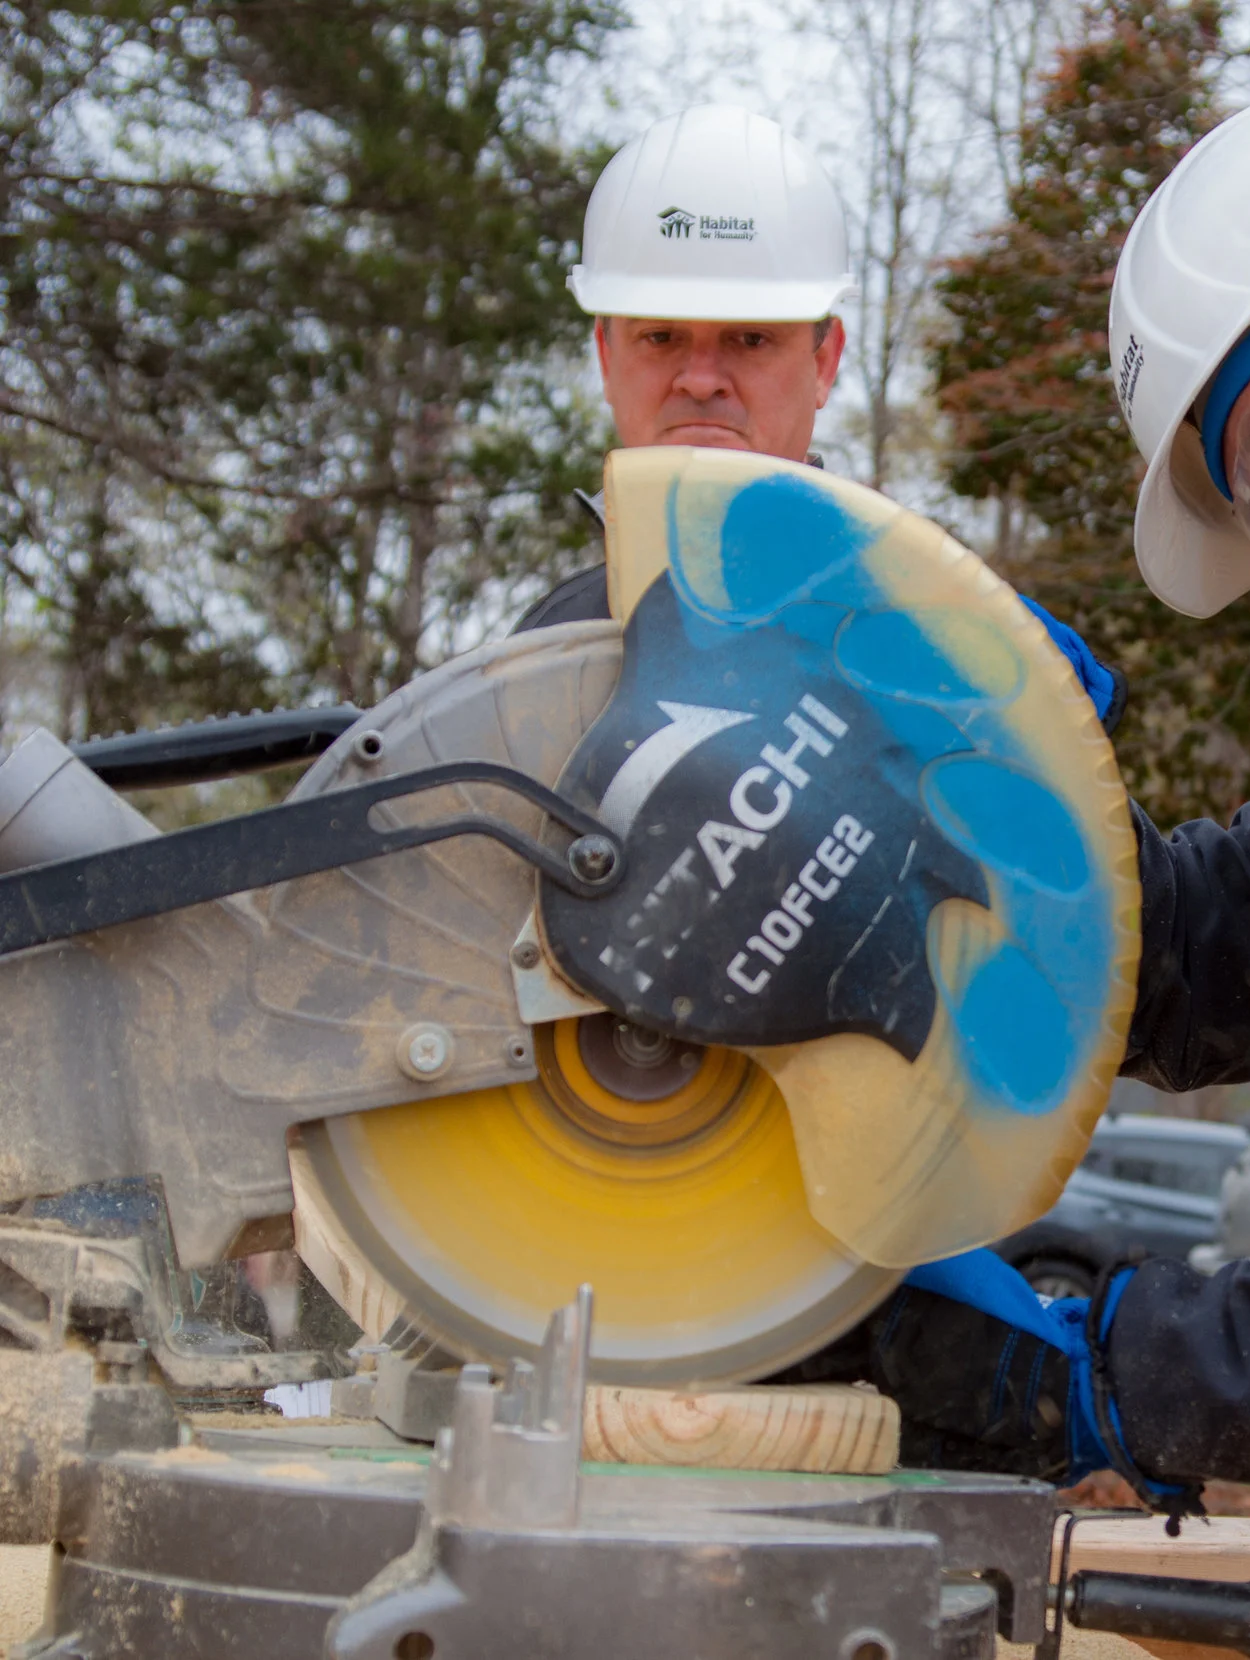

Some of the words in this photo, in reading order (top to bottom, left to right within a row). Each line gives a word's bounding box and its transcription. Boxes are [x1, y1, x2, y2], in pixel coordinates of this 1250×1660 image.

[699, 215, 755, 230] Habitat
[700, 231, 711, 239] for
[714, 231, 755, 241] Humanity
[1119, 333, 1138, 411] abitat
[726, 813, 875, 995] C10FCE2
